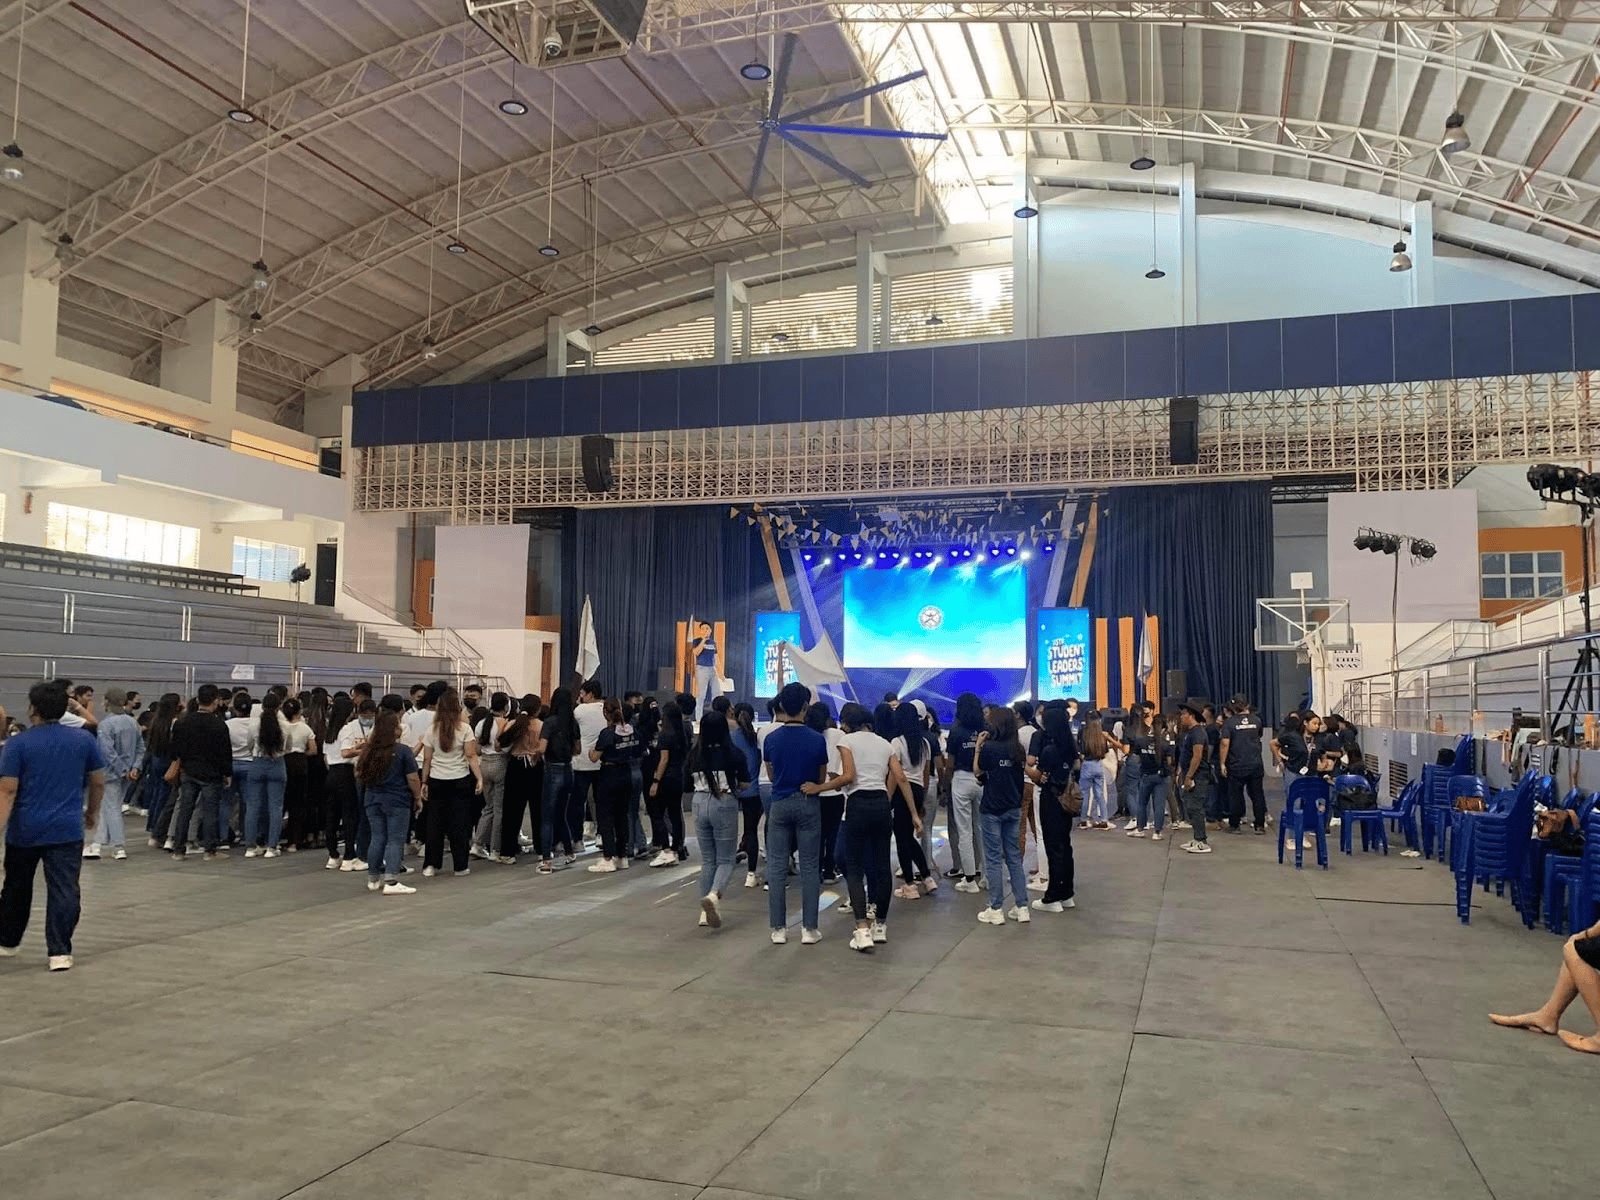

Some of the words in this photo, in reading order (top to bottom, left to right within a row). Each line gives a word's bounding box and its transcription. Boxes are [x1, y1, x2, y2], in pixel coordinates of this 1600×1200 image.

[1047, 643, 1085, 660] STUDENT
[764, 657, 794, 673] LEAERS
[1051, 672, 1083, 688] SUMMIT
